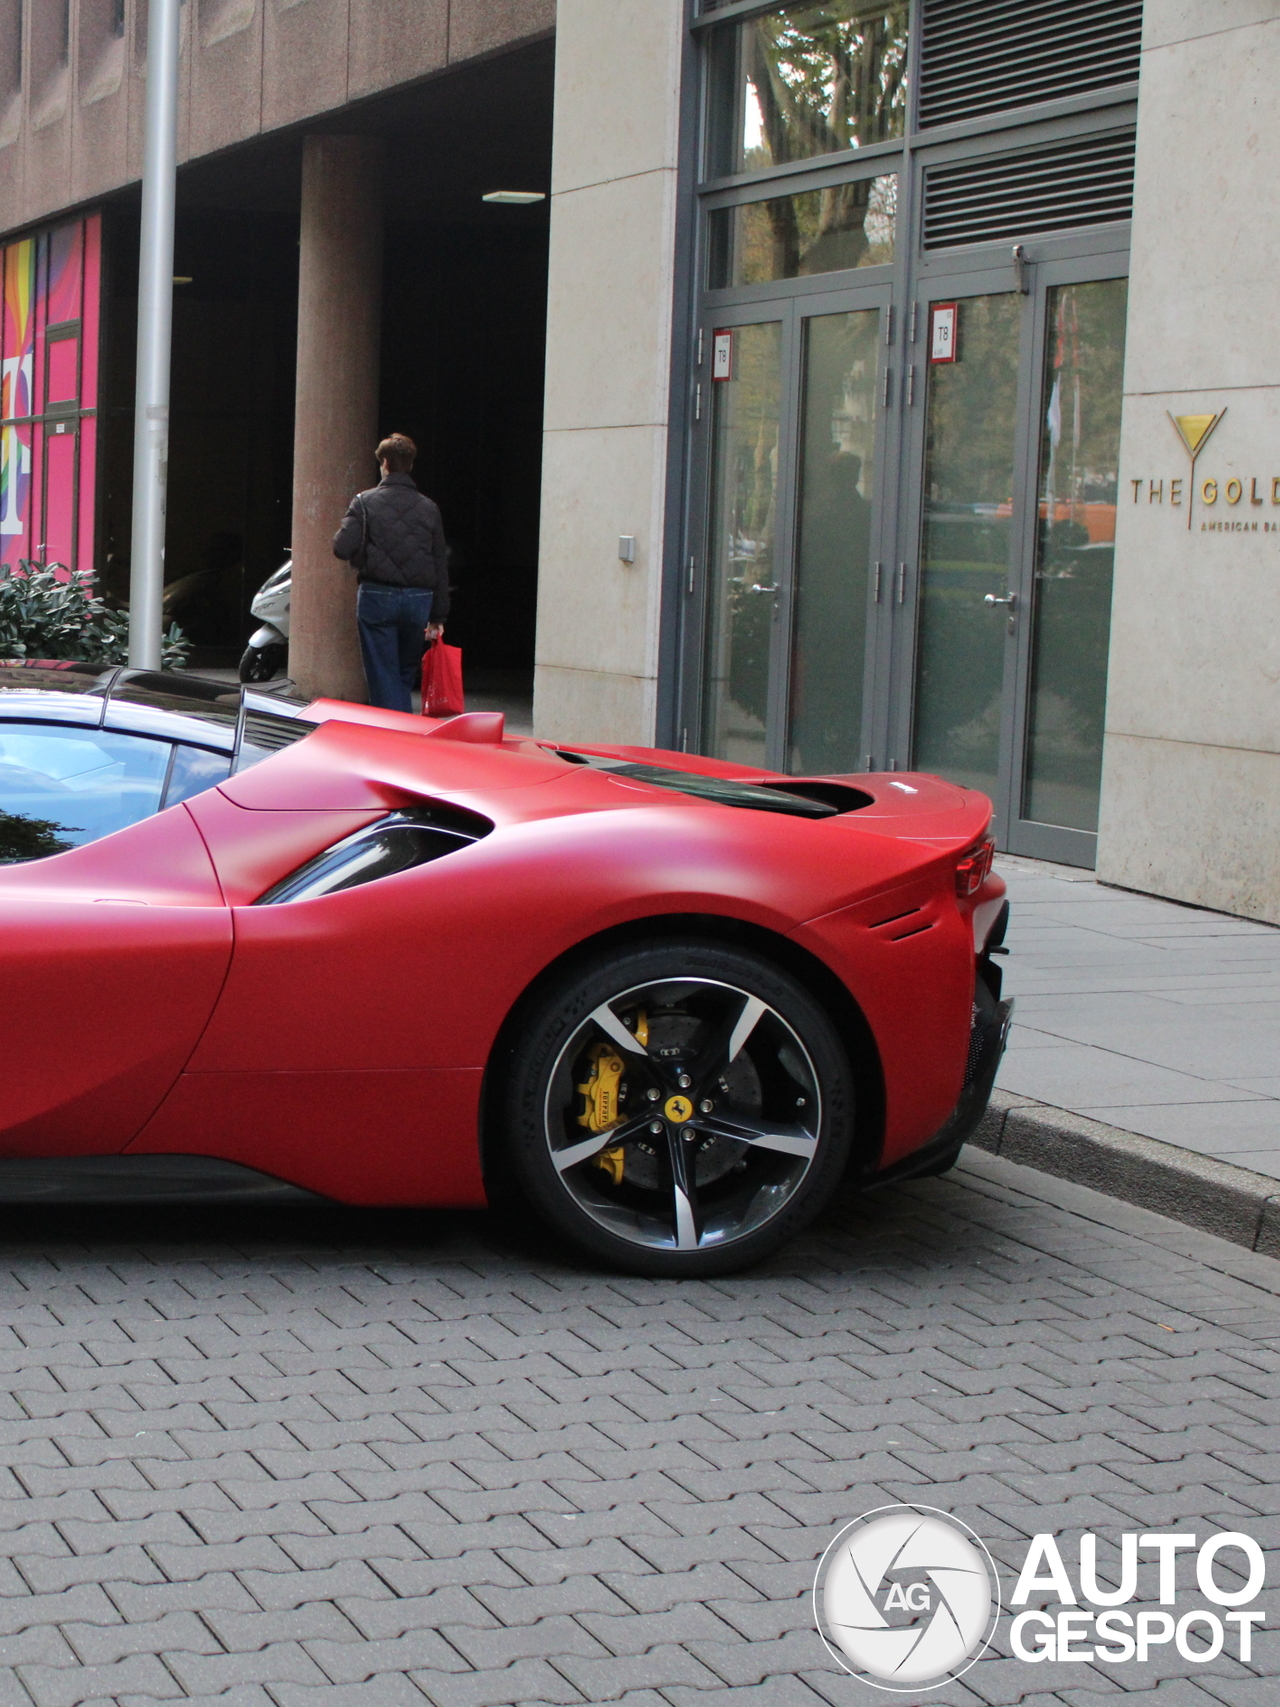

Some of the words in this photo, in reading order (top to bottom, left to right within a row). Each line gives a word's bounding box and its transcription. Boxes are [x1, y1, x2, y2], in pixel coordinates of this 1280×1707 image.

[938, 326, 948, 341] T8
[718, 350, 726, 362] T8
[1131, 479, 1182, 505] THE
[1201, 522, 1258, 532] AMERICAN
[1264, 522, 1280, 532] BA
